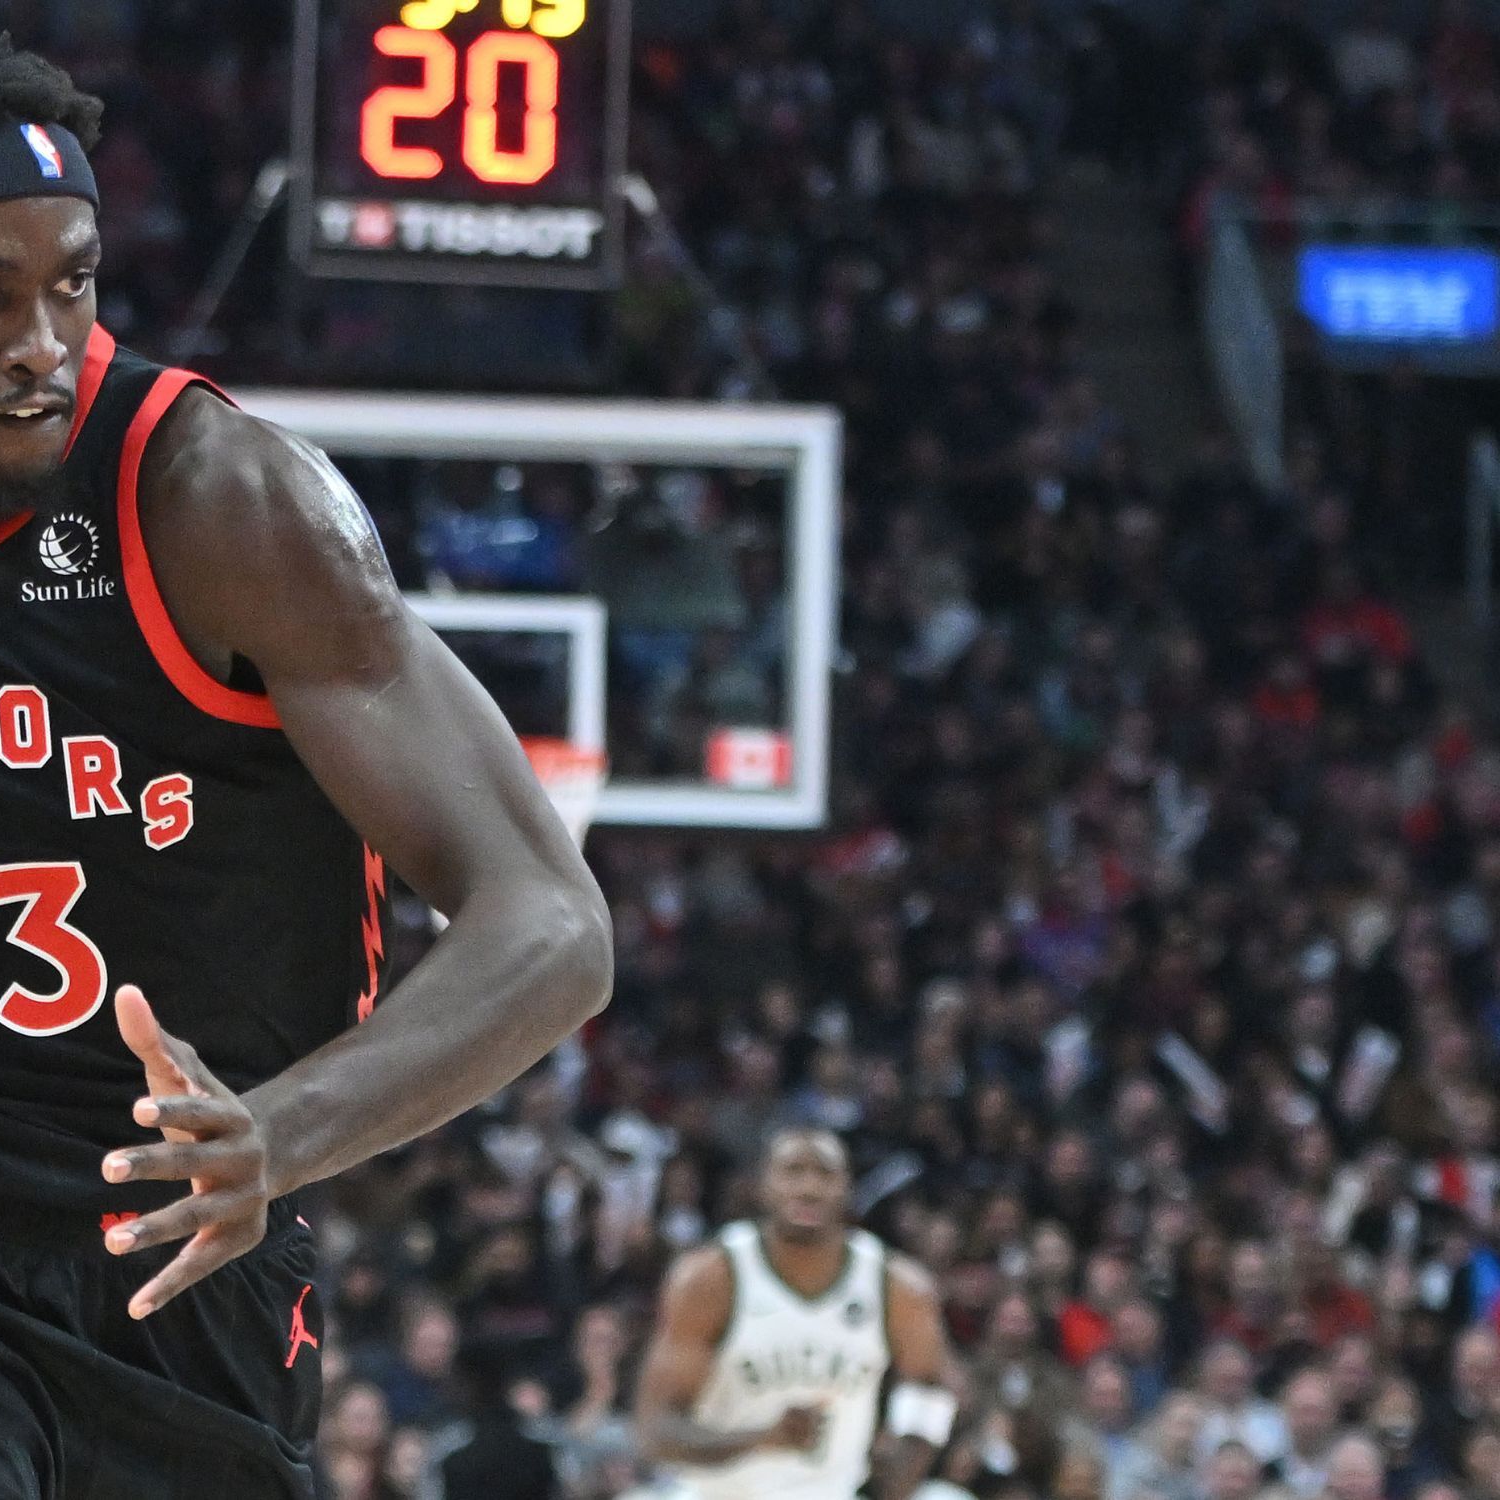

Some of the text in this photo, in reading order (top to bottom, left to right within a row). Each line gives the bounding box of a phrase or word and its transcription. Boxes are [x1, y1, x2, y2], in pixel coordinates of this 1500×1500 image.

[360, 25, 559, 184] 20
[21, 575, 115, 602] Sun Life
